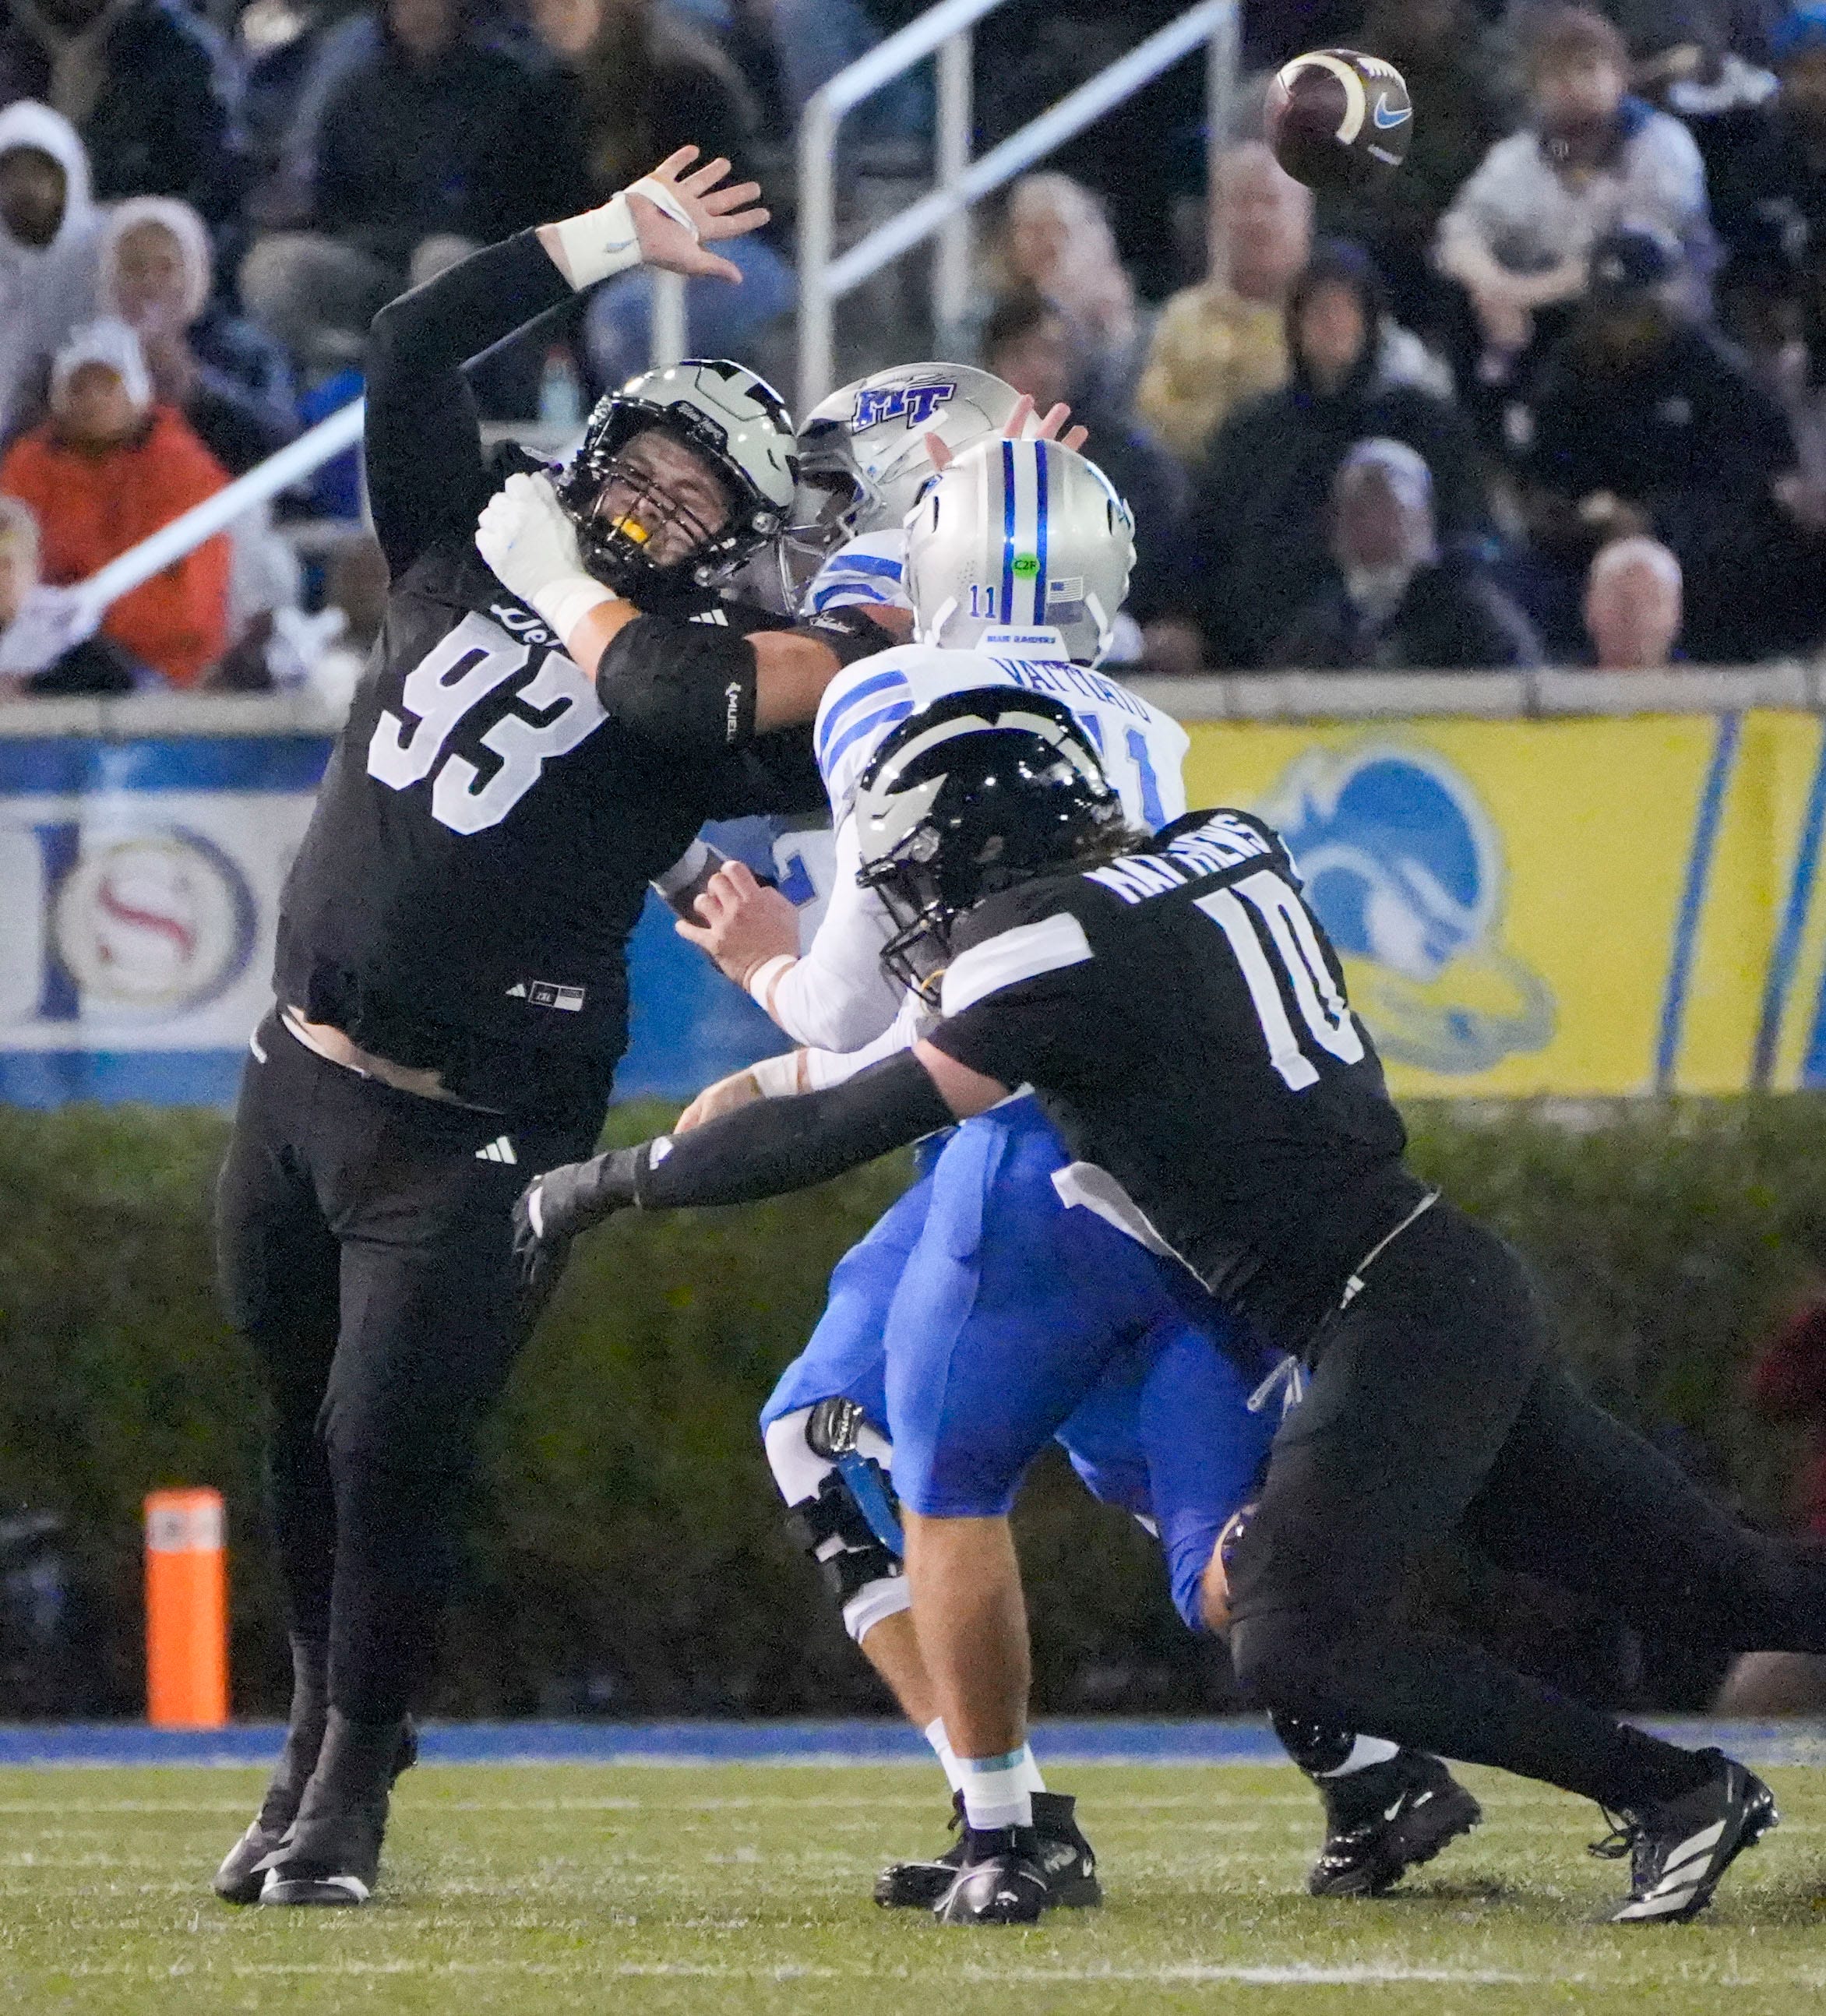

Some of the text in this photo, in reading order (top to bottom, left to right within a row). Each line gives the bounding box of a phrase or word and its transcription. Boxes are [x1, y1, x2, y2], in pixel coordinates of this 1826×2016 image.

[851, 382, 957, 435] MT
[970, 585, 996, 619] 11
[368, 610, 610, 836] 93
[1194, 869, 1365, 1091] 10
